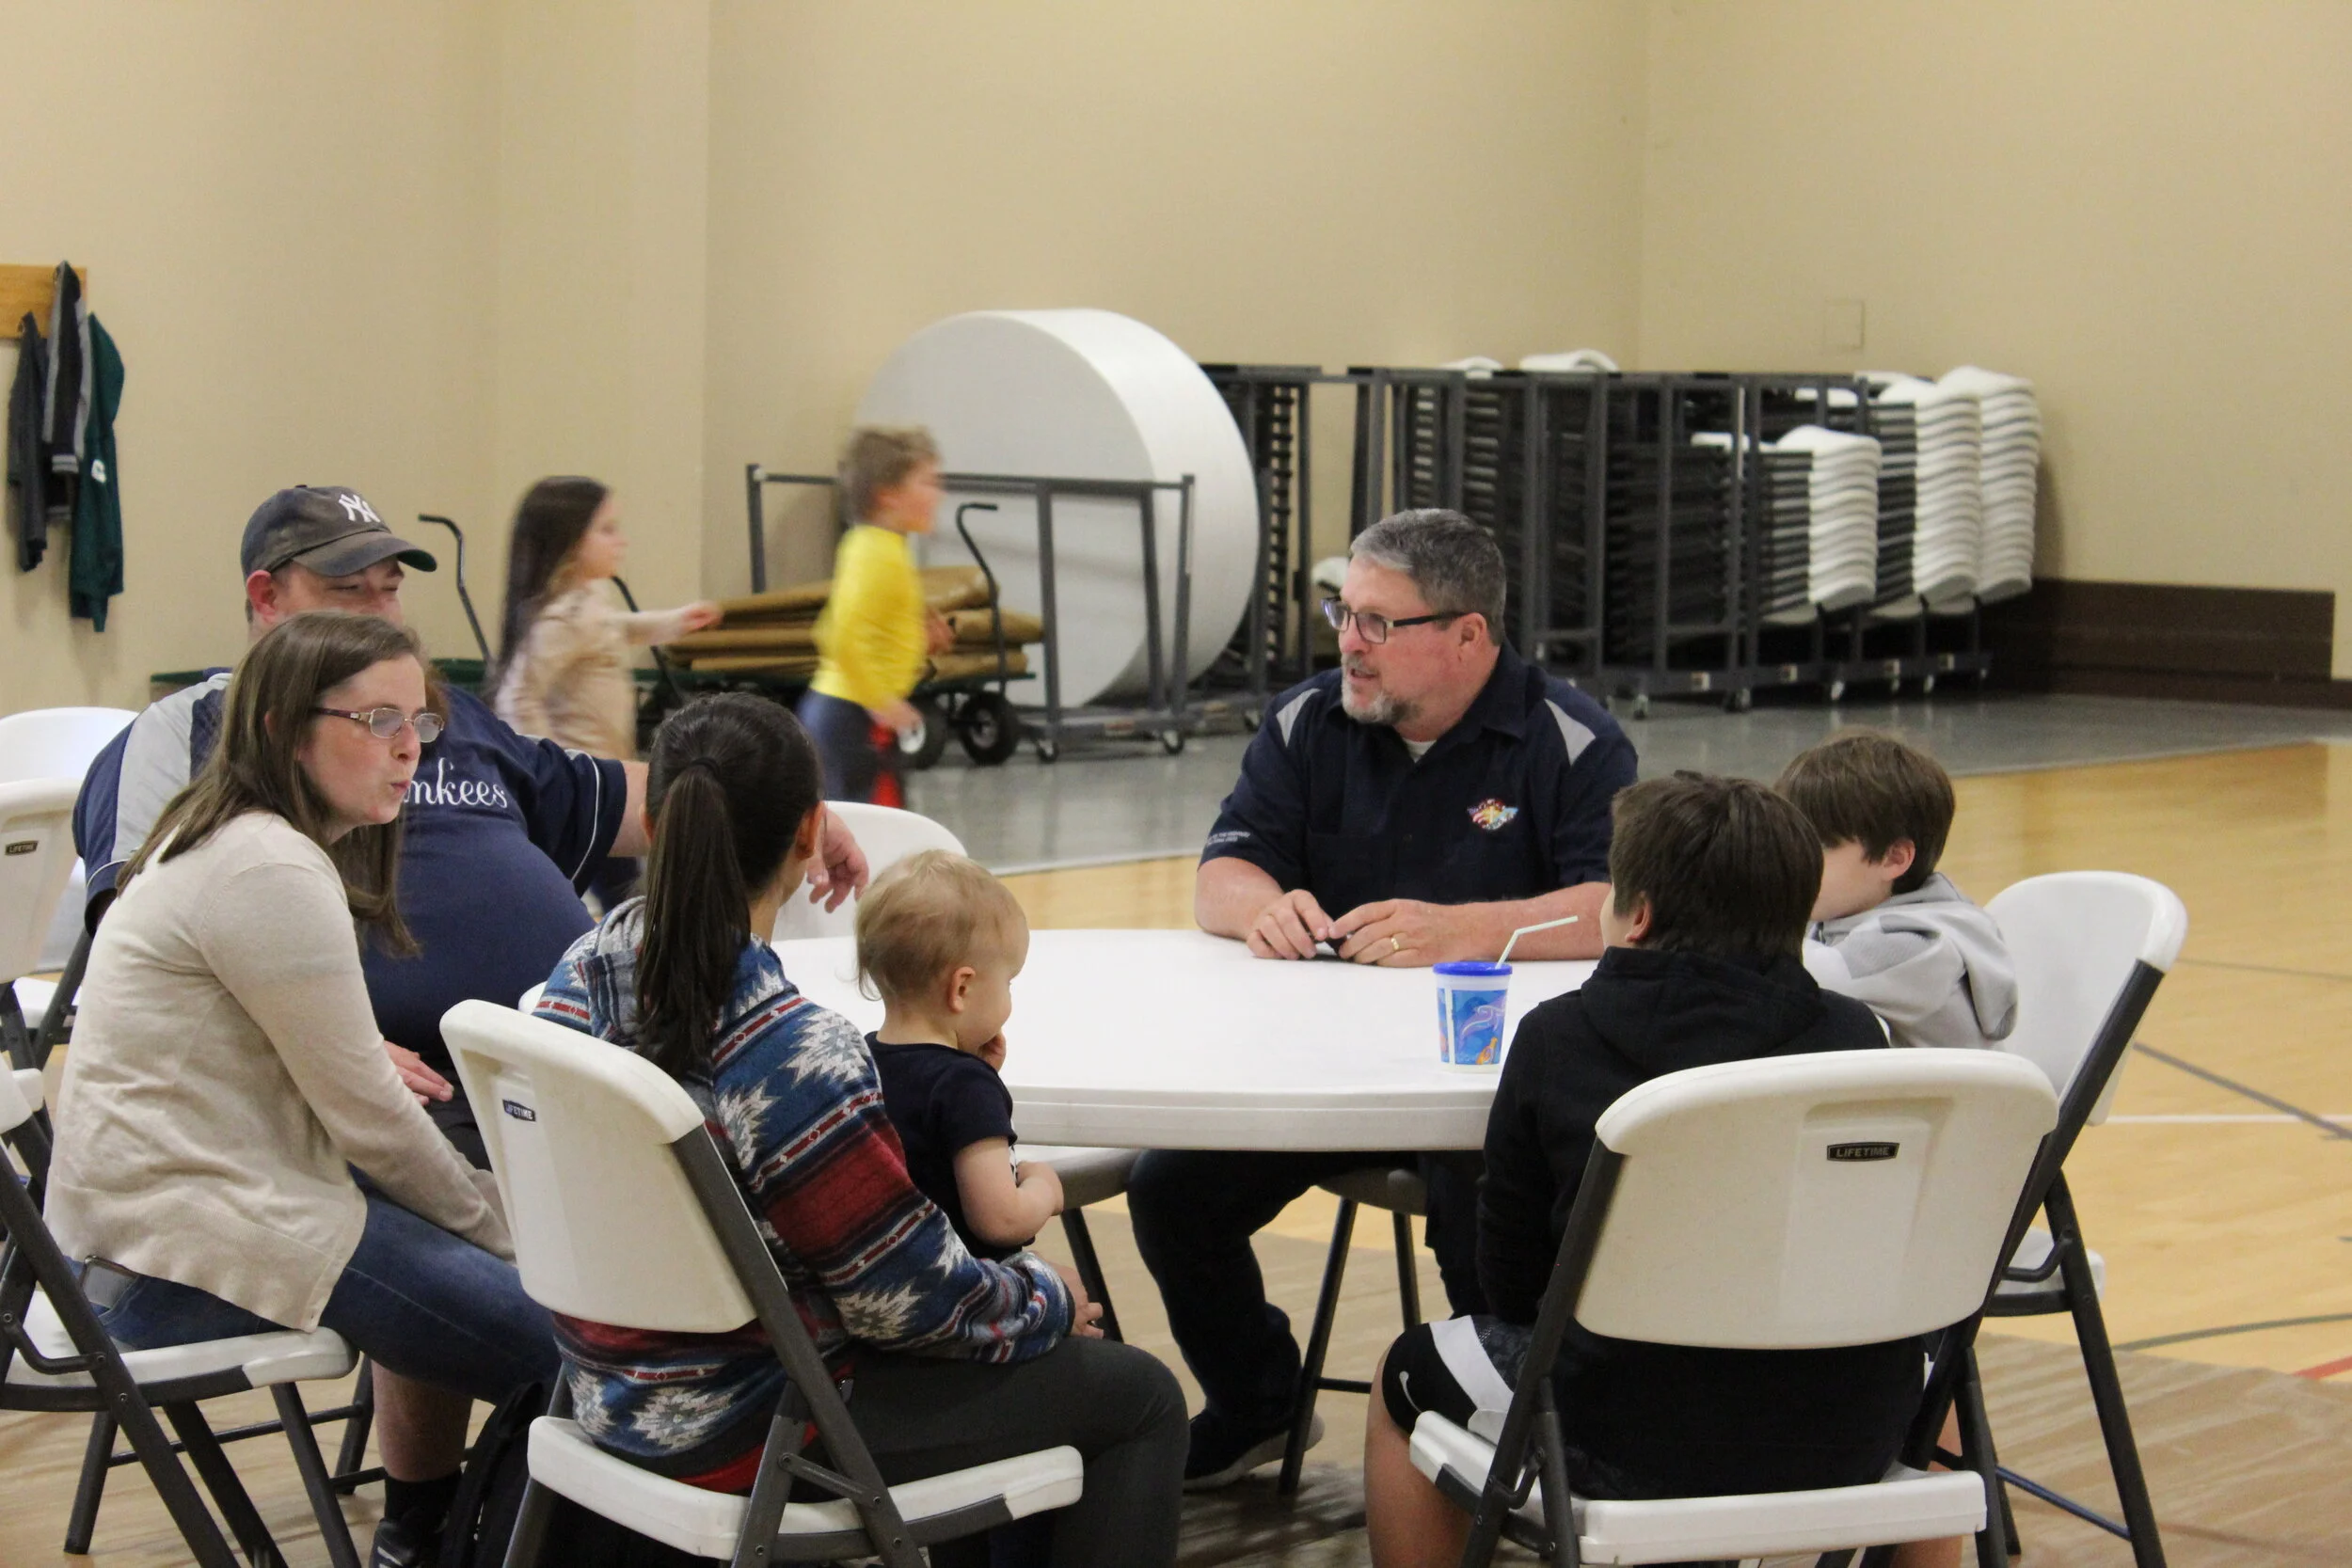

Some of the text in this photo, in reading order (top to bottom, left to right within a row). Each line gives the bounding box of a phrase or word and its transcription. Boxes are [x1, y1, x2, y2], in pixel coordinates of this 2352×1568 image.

[339, 494, 381, 523] NY
[405, 757, 508, 809] nkees
[1836, 1147, 1889, 1158] LIFETIME
